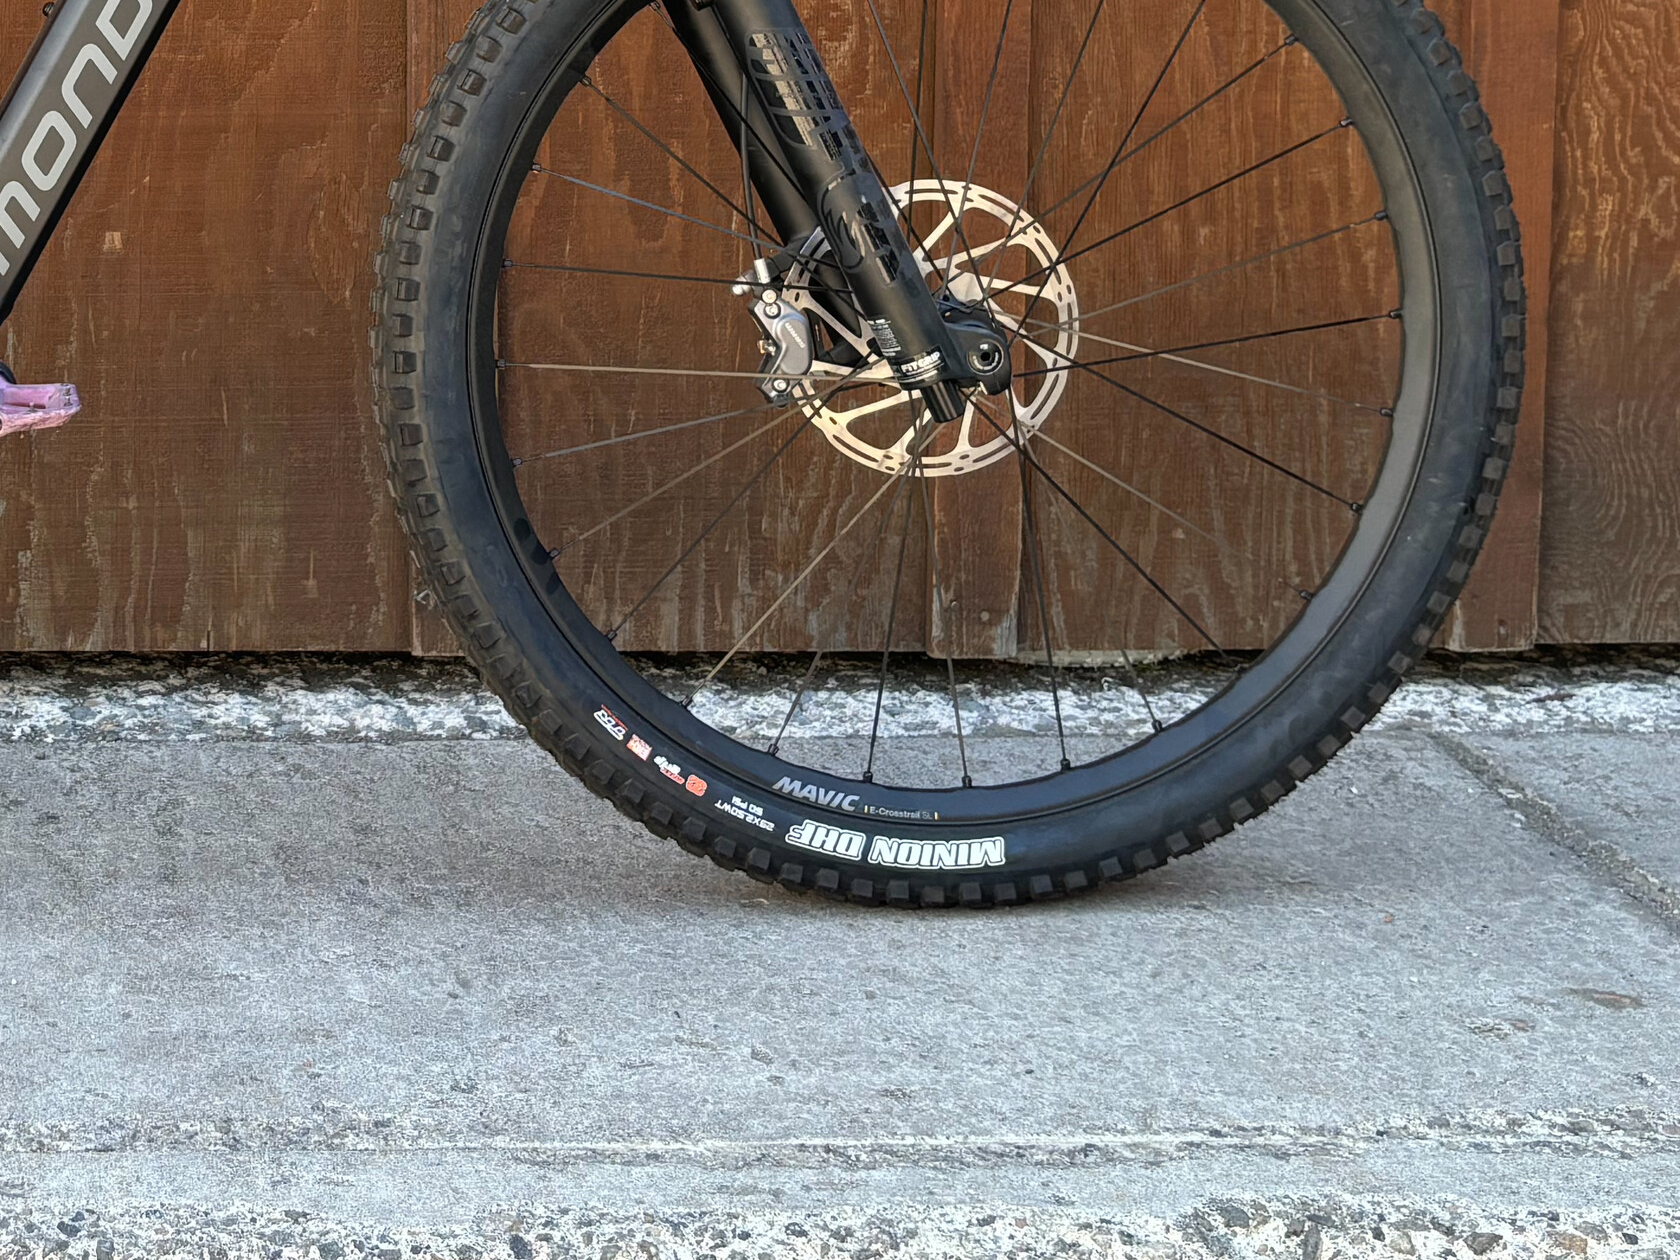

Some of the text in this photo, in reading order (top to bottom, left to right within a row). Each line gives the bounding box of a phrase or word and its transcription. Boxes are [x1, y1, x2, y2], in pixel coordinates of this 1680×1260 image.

[772, 776, 861, 812] MAVIC
[785, 819, 1006, 869] MINION DHF
